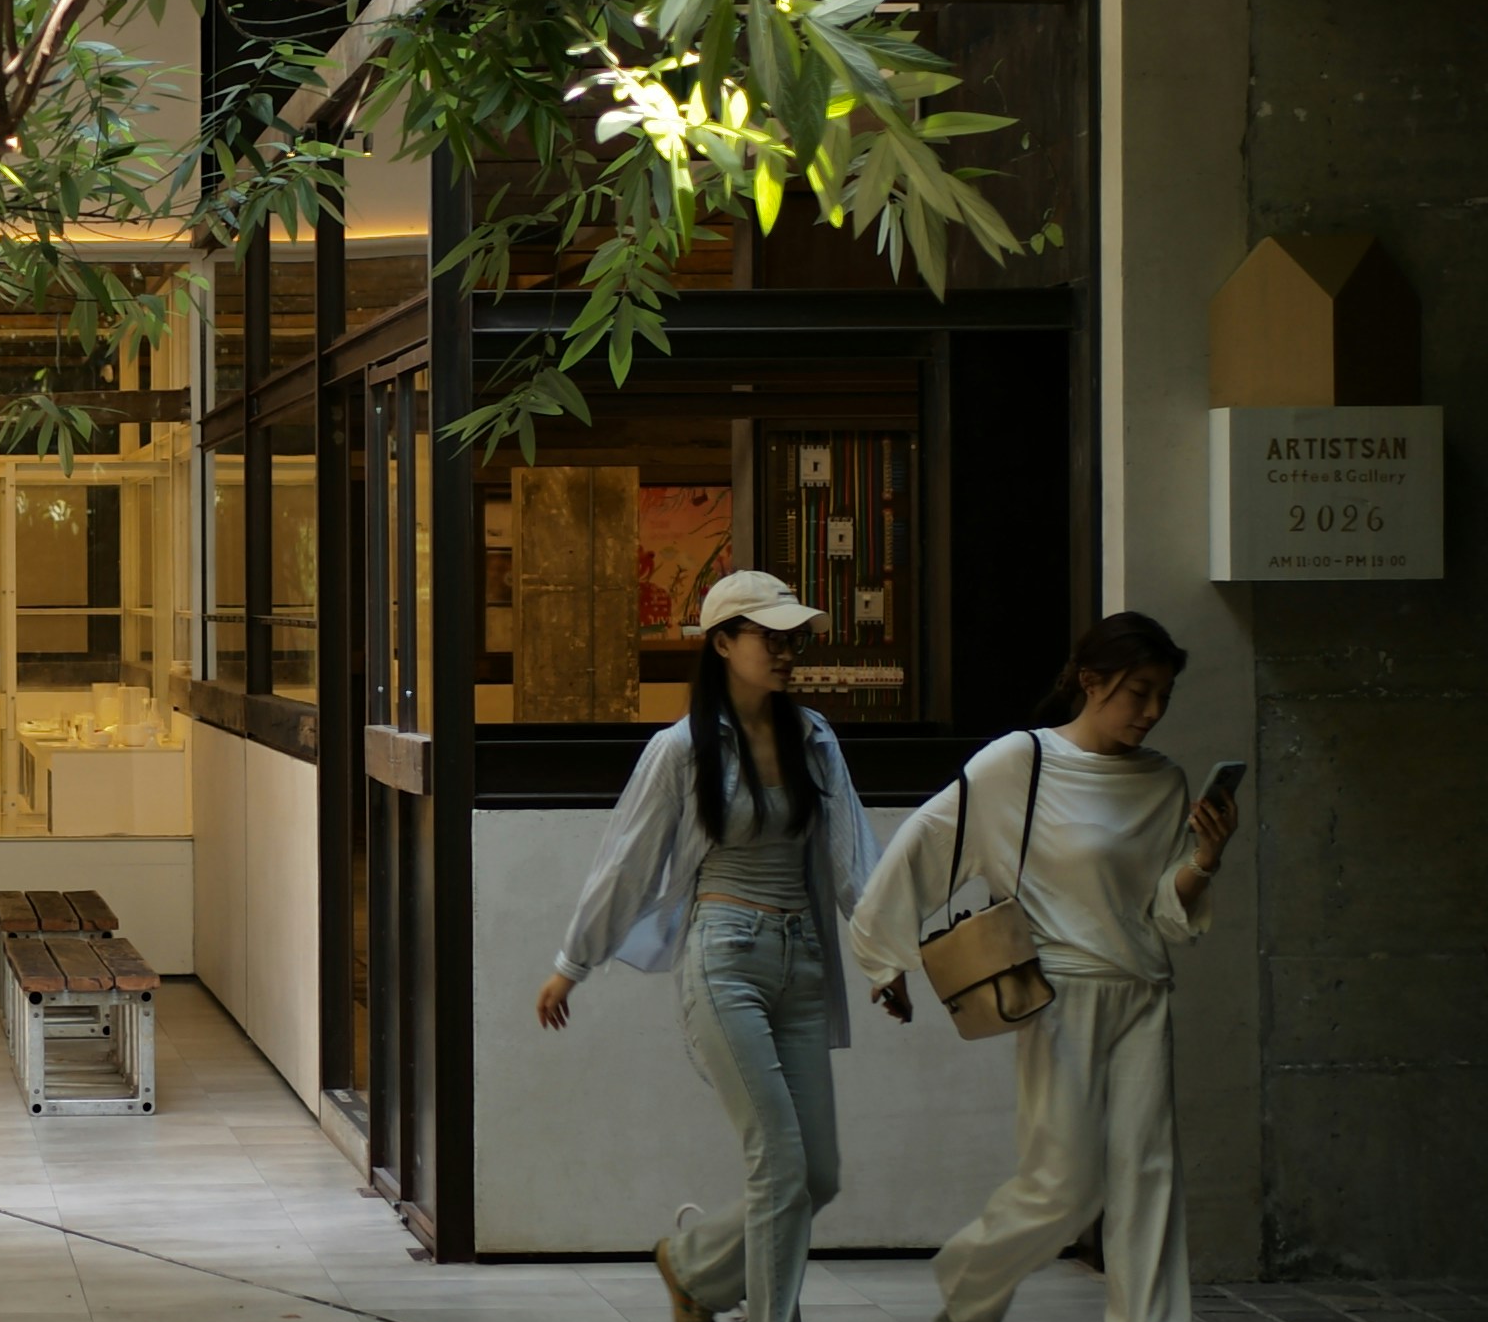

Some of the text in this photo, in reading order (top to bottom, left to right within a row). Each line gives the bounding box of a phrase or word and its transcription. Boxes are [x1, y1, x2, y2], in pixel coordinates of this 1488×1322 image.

[1267, 438, 1407, 460] ARTISTSAN
[1288, 504, 1384, 532] 2026
[1268, 556, 1292, 567] AM
[1345, 555, 1367, 567] PM
